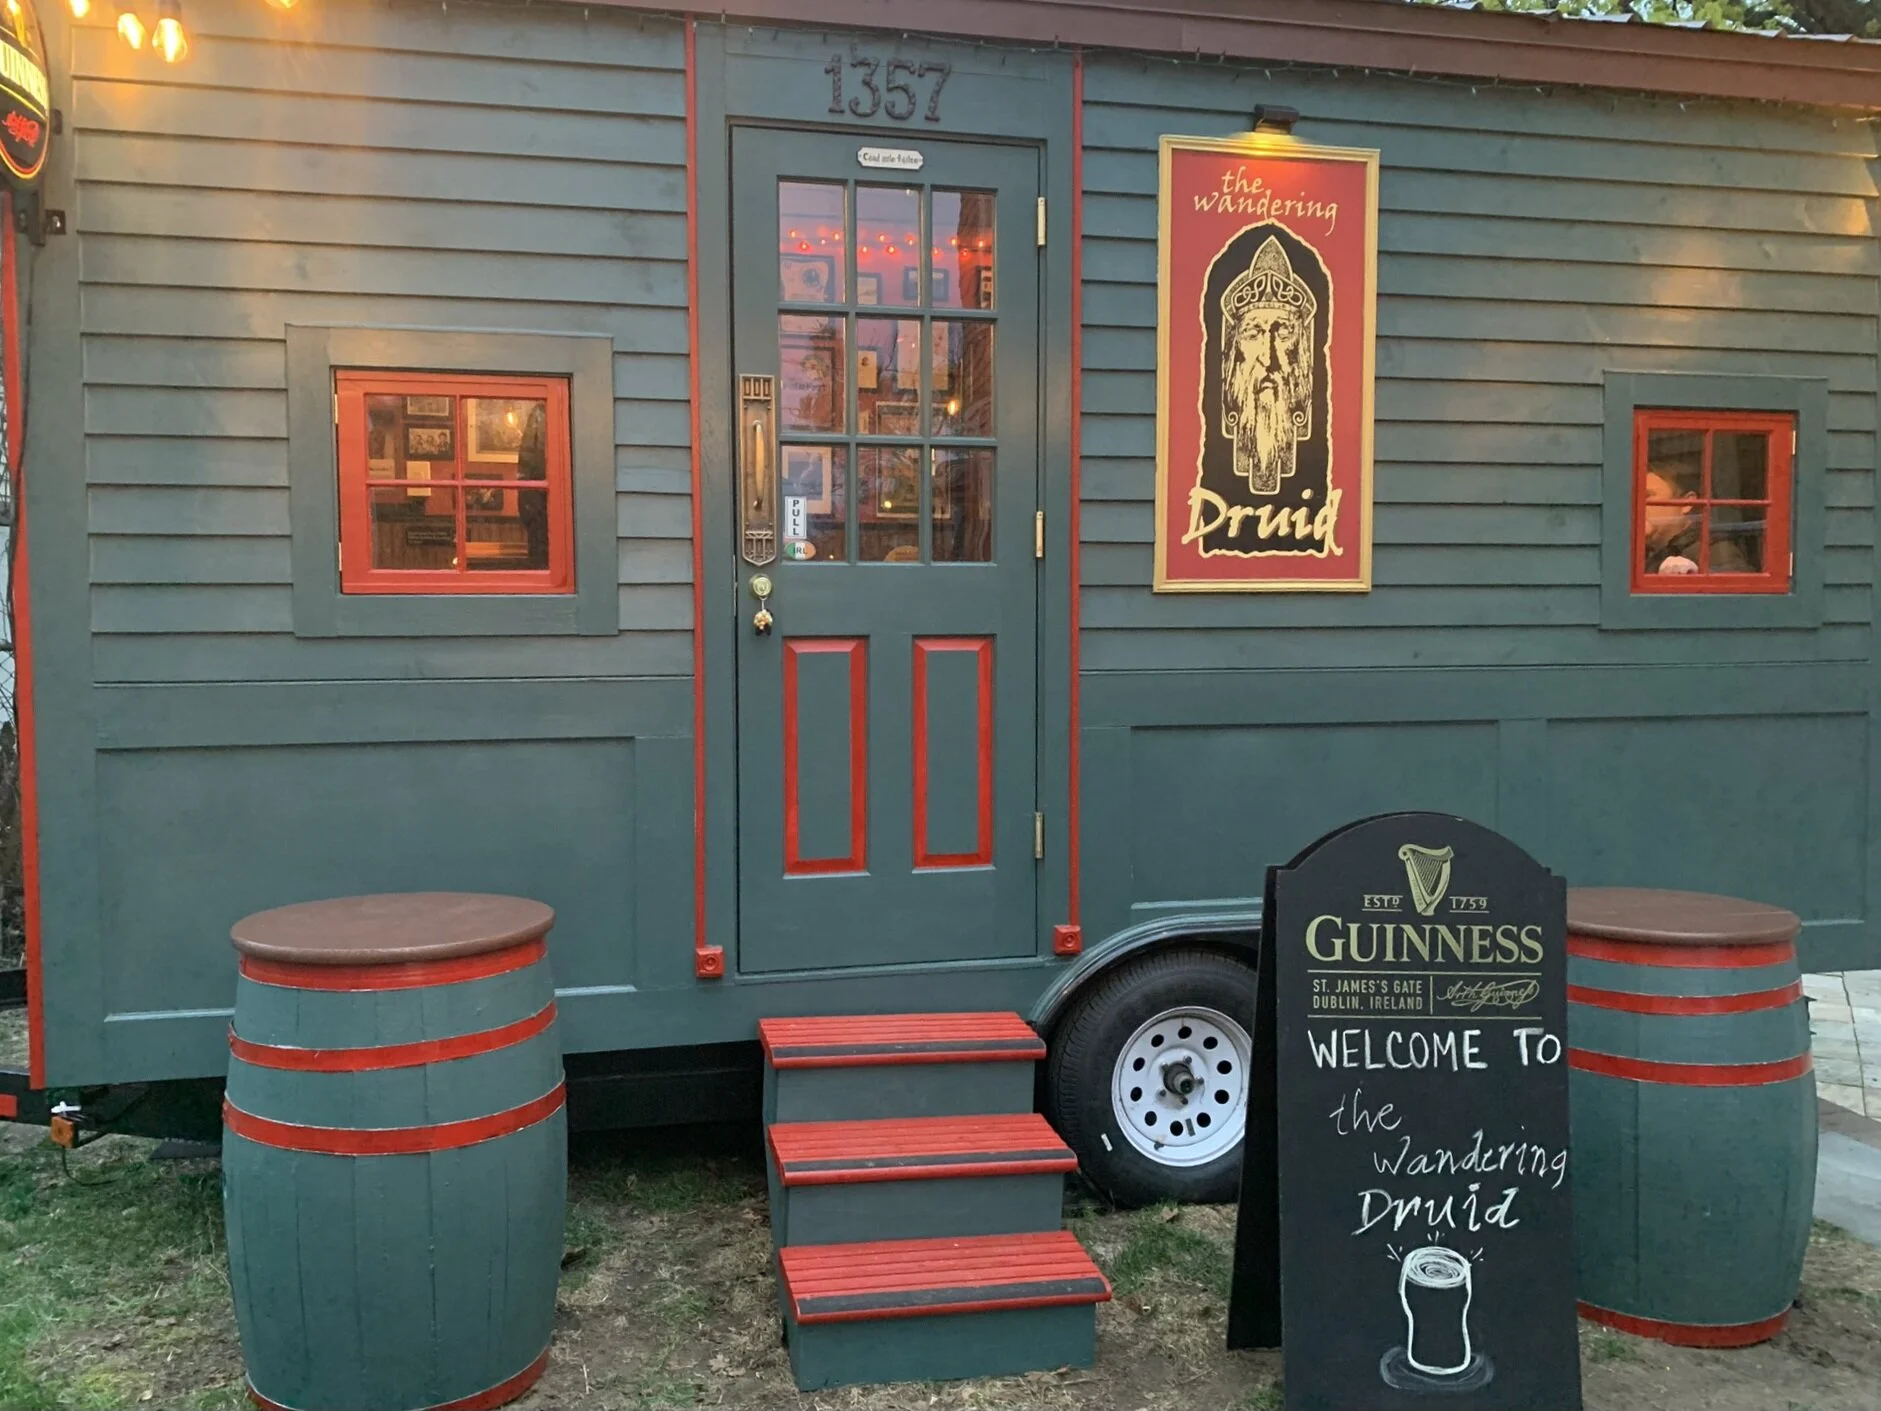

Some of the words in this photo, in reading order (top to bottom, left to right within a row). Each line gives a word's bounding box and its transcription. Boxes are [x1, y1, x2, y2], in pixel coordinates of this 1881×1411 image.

[824, 54, 952, 122] 1357
[1221, 166, 1264, 194] the
[1194, 189, 1338, 236] wandering
[792, 499, 800, 536] PULL
[1181, 487, 1344, 556] Druid
[793, 546, 808, 555] IRL
[1451, 897, 1488, 909] 1759
[1305, 914, 1544, 964] GUINNESS
[1313, 979, 1330, 993] ST.
[1336, 980, 1387, 994] JAMES'S
[1394, 980, 1422, 994] GATE
[1370, 996, 1423, 1010] IRELAND
[1307, 1029, 1488, 1072] WELCOME
[1513, 1027, 1562, 1066] TO
[1329, 1087, 1402, 1135] the
[1351, 1182, 1520, 1235] Druid
